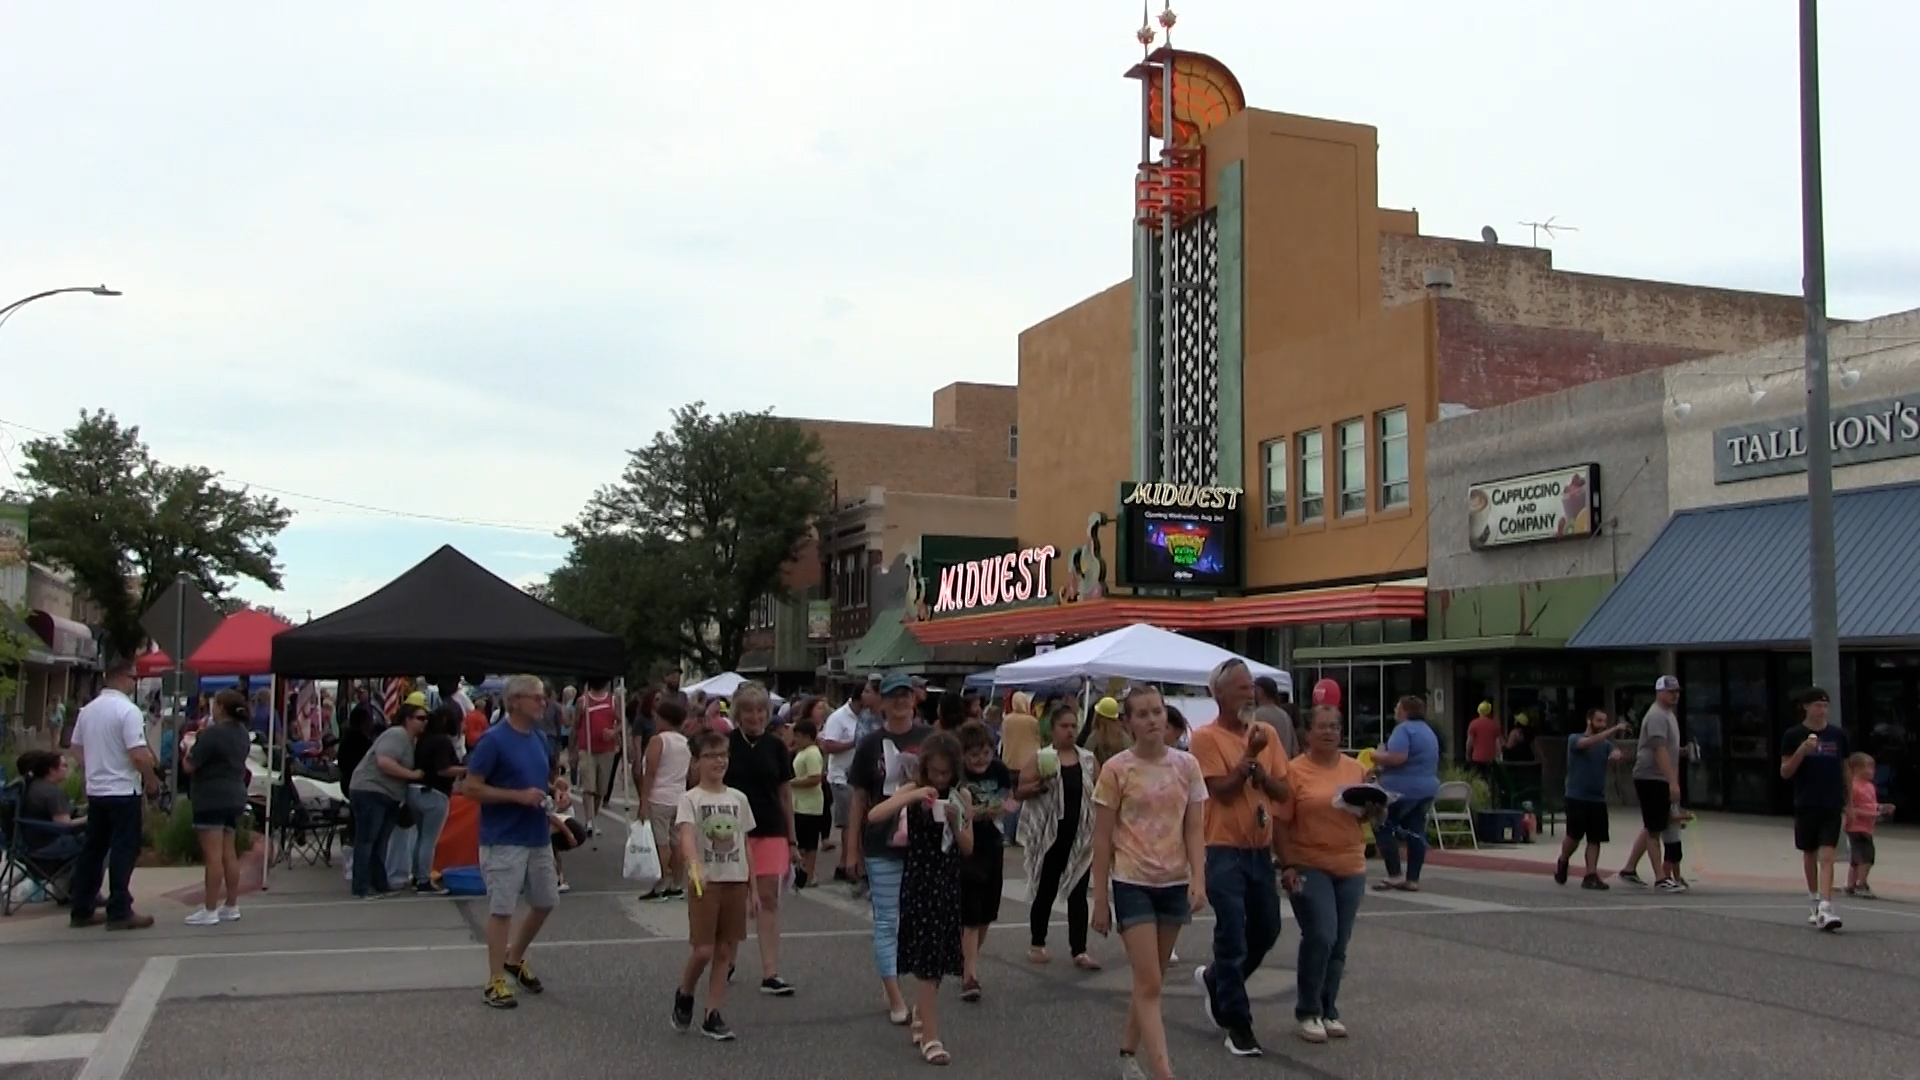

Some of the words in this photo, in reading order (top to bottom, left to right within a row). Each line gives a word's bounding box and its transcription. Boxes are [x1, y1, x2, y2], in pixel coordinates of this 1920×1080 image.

[1123, 482, 1244, 510] MIDWEST
[1516, 503, 1537, 515] AND
[933, 545, 1056, 612] MIDWEST
